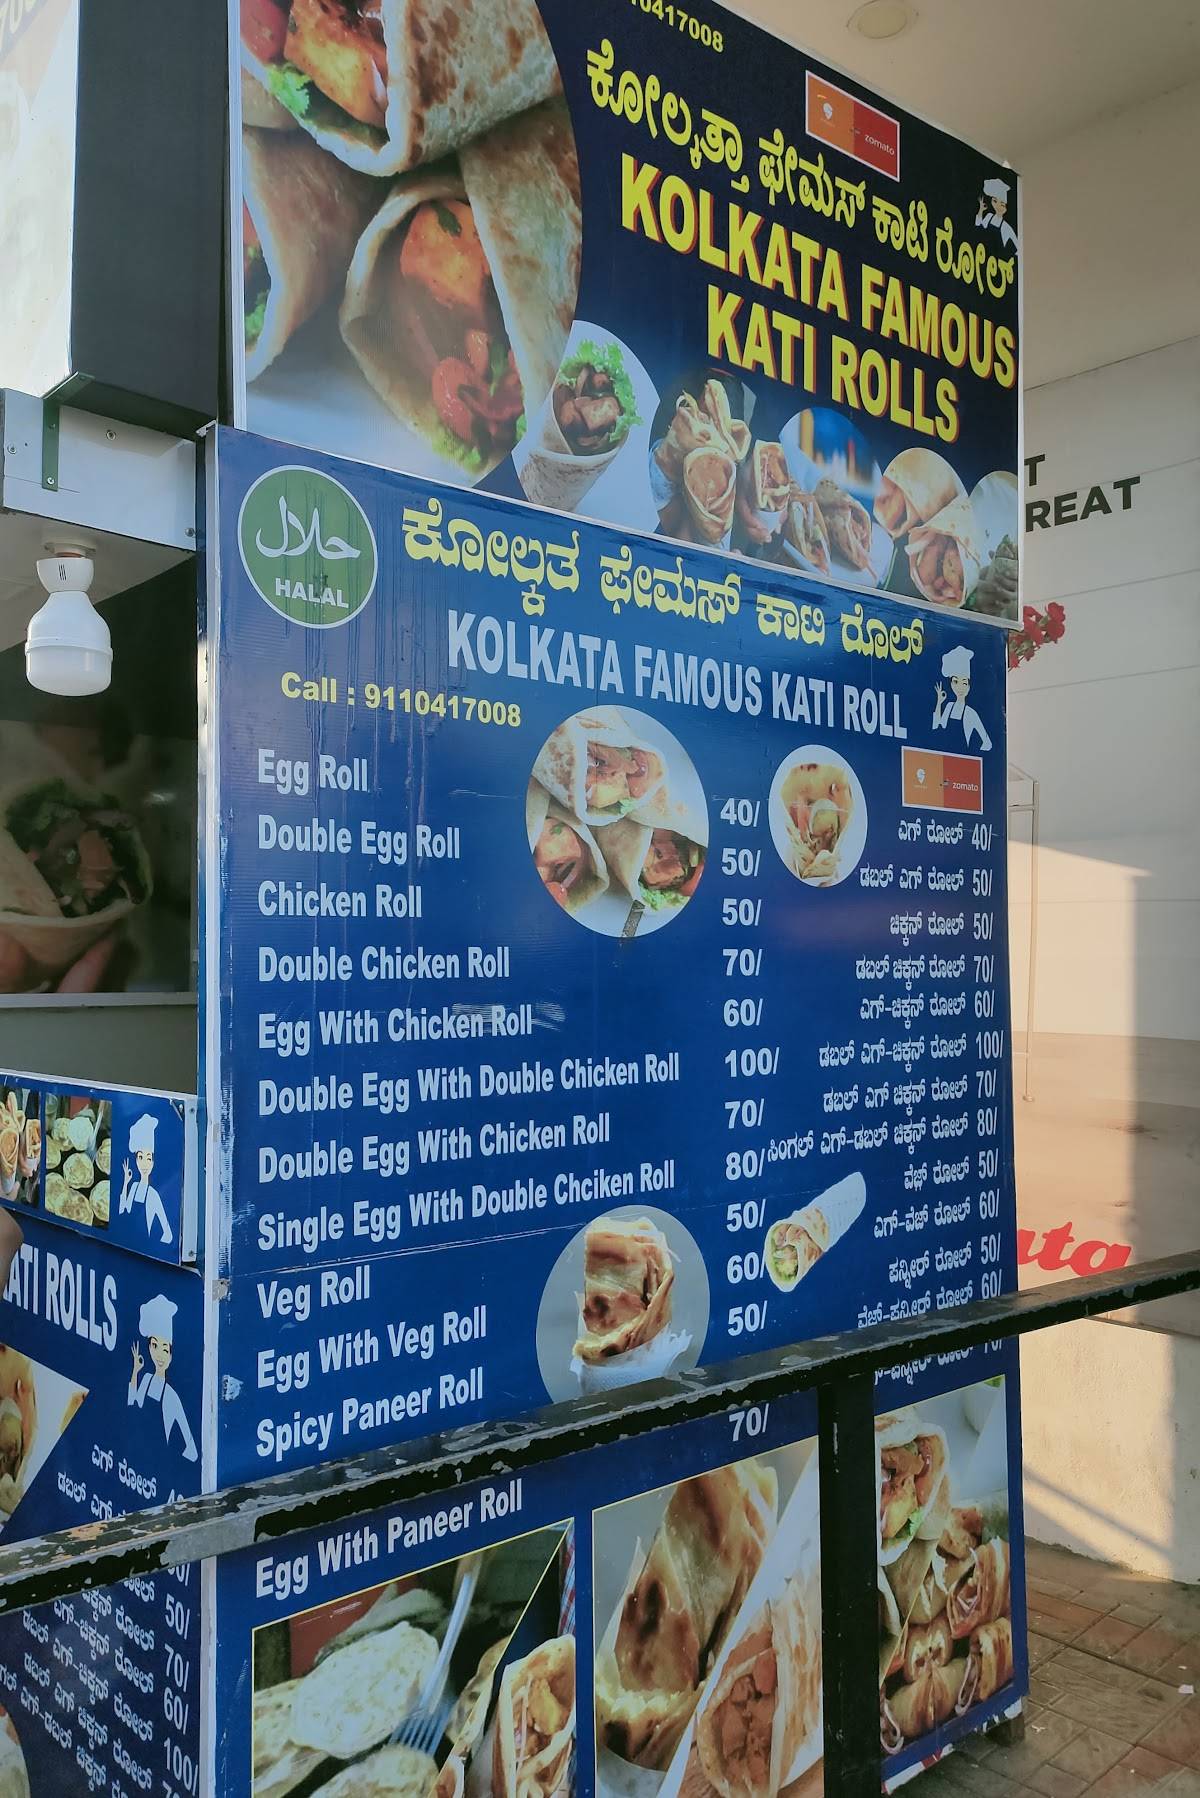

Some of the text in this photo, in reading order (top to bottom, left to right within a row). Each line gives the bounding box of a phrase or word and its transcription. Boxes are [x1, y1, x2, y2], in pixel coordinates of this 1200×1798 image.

[864, 134, 896, 156] zomato
[758, 128, 866, 228] ಫೇಮಸ್
[872, 195, 929, 263] ಕಾಟಿ
[935, 216, 1015, 299] ರೋಲ್
[621, 153, 1016, 388] KOLKATA FAMOUS
[708, 284, 960, 443] KATI ROLLS
[256, 495, 361, 560] حلال
[402, 497, 580, 617] ಕೋಲ್ಕತ
[600, 545, 742, 625] ಫೇಮಸ್
[275, 577, 350, 609] HALAL
[448, 609, 907, 739] KOLKATA FAMOUS KATI ROLL
[282, 672, 336, 703] Call
[365, 684, 520, 727] 9110417008
[258, 748, 367, 796] Egg Roll
[952, 781, 979, 793] zomato
[721, 798, 760, 827] 40/
[259, 814, 459, 865] Double Egg Roll
[927, 819, 963, 844] ರೋಲ್
[972, 823, 992, 851] 40/
[722, 848, 760, 876] 50/
[258, 881, 421, 917] Chicken Roll
[928, 866, 964, 891] ರೋಲ್
[973, 869, 992, 896] 50/
[723, 898, 761, 926] 50/
[928, 911, 964, 935] ರೋಲ್
[974, 912, 993, 940] 50/
[259, 946, 509, 981] Double Chicken Roll
[723, 949, 762, 976] 70/
[929, 954, 965, 978] ರೋಲ್
[974, 955, 994, 983] 70/
[724, 999, 763, 1026] 60/
[930, 992, 965, 1016] ರೋಲ್
[975, 990, 994, 1018] 60/
[259, 1004, 536, 1057] Egg With Chicken Roll
[930, 1033, 966, 1058] ರೋಲ್
[976, 1030, 1003, 1059] 100/
[725, 1047, 779, 1077] 100/
[259, 1053, 679, 1115] Double Egg With Double Chicken Roll
[931, 1075, 967, 1101] ರೋಲ್
[976, 1069, 996, 1098] 70/
[725, 1099, 764, 1128] 70/
[932, 1112, 968, 1139] ರೋಲ್
[977, 1107, 997, 1136] 80/
[259, 1112, 609, 1183] Double Egg With Chicken Roll
[726, 1149, 765, 1180] 80/
[933, 1156, 969, 1184] ರೋಲ್
[979, 1148, 998, 1179] 50/
[258, 1160, 674, 1253] Single Egg With Double Chciken Roll
[727, 1199, 766, 1232] 50/
[934, 1197, 970, 1225] ರೋಲ್
[979, 1189, 999, 1219] 60/
[726, 1252, 765, 1284] 60/
[935, 1241, 971, 1271] ರೋಲ್
[981, 1233, 1000, 1264] 50/
[3, 1243, 117, 1351] ATI ROLLS
[257, 1265, 369, 1321] Veg Roll
[981, 1268, 1003, 1300] 60/
[728, 1301, 767, 1336] 50/
[258, 1305, 486, 1393] Egg With Veg Roll
[257, 1367, 482, 1462] Spicy Paneer Roll
[727, 1403, 769, 1441] 70/
[257, 1478, 521, 1600] Egg With Paneer Roll
[168, 1563, 190, 1587] 0/
[165, 1594, 190, 1640] 50/
[165, 1644, 189, 1692] 70/
[164, 1687, 188, 1735] 60/
[163, 1738, 198, 1798] 100/
